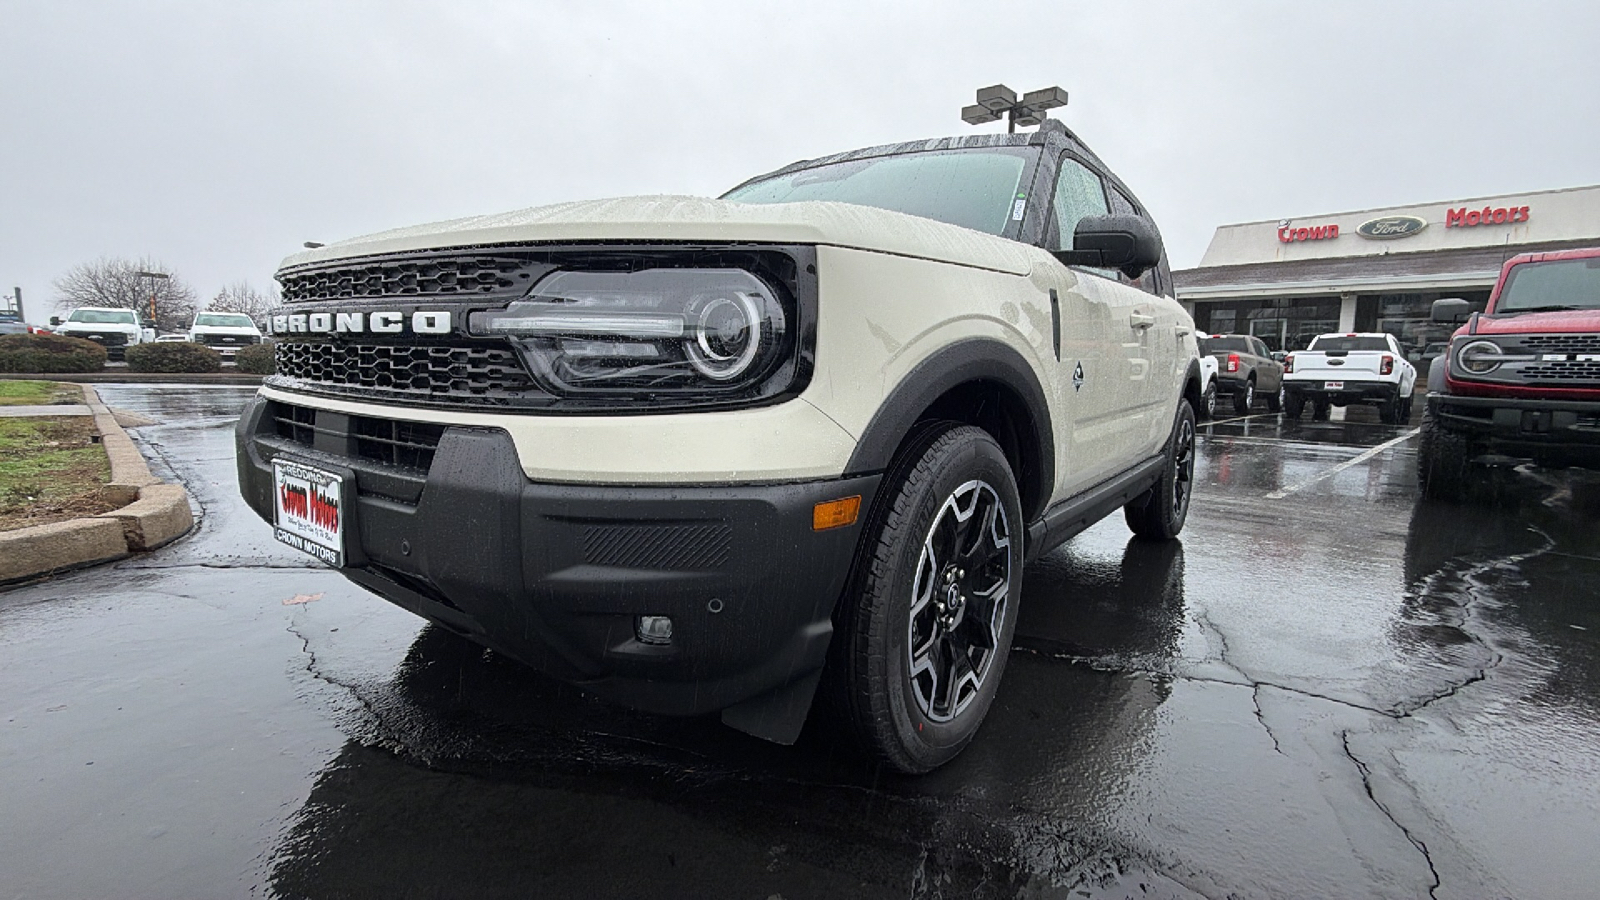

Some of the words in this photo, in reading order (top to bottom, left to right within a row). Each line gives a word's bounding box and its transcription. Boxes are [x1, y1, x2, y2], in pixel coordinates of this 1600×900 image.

[1278, 224, 1339, 243] Crown
[1372, 220, 1409, 235] Ford
[1445, 205, 1530, 228] Motors
[272, 312, 451, 333] BRONCO
[286, 465, 322, 484] REDDING
[277, 529, 303, 549] CROWN
[304, 540, 336, 563] MOTORS
